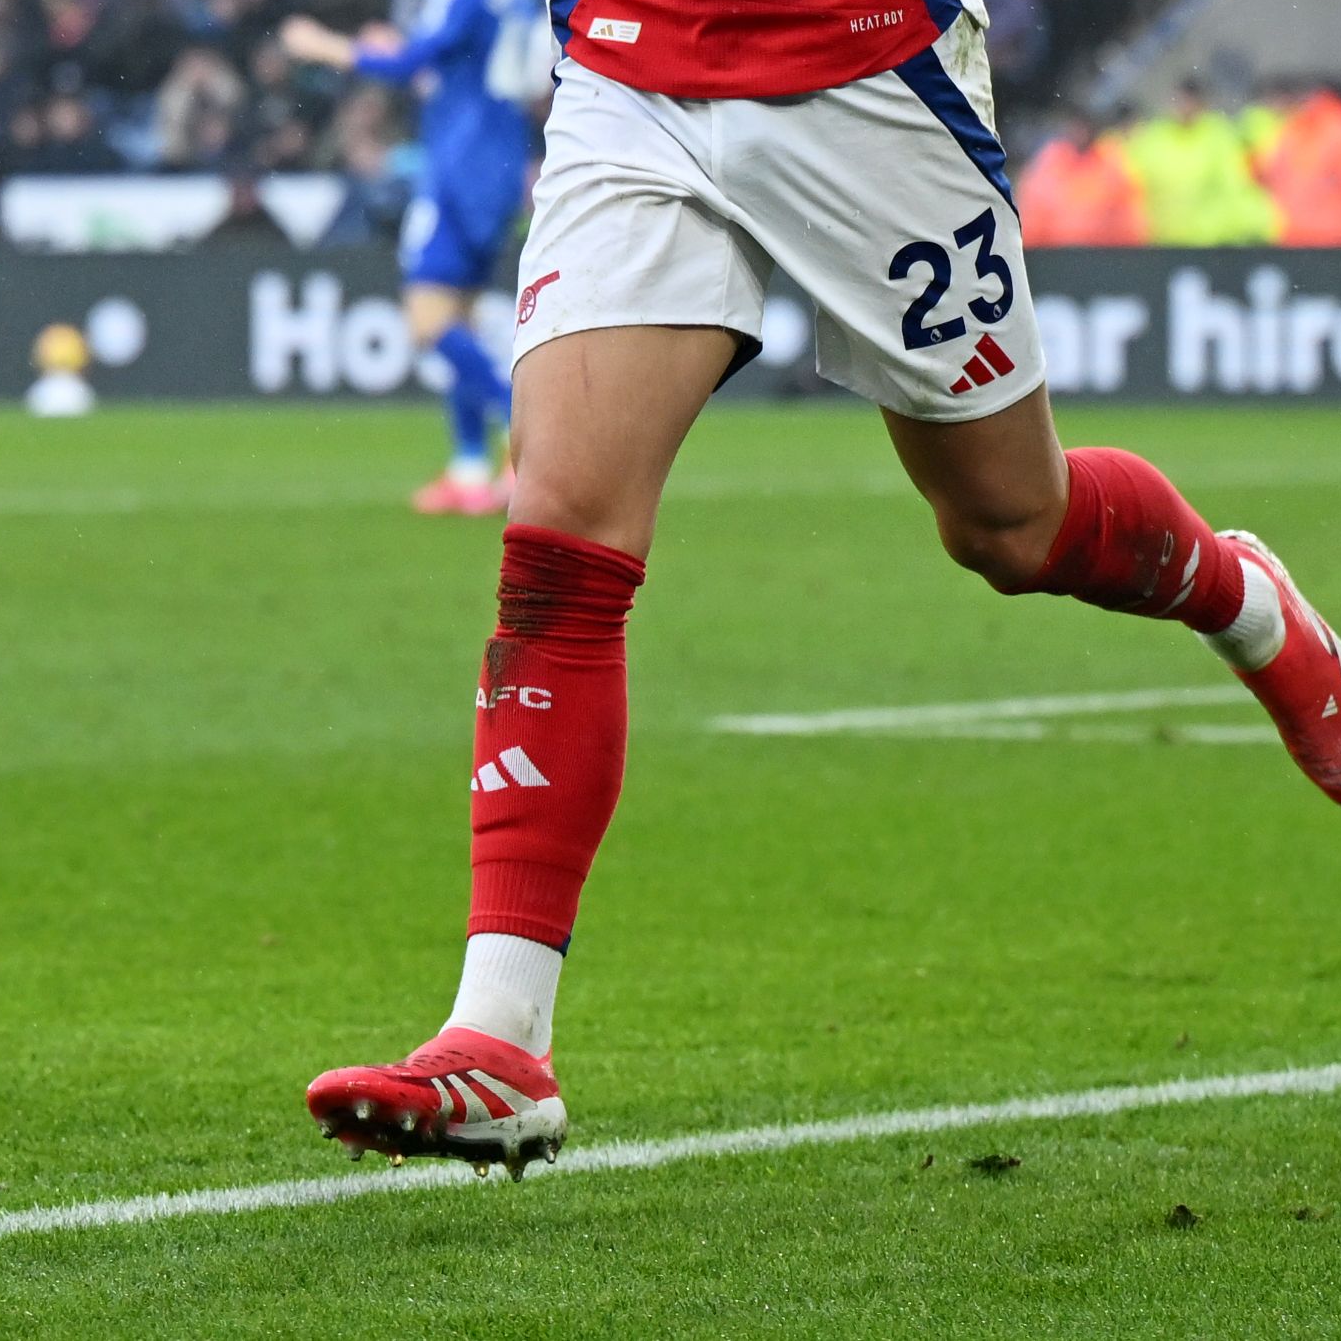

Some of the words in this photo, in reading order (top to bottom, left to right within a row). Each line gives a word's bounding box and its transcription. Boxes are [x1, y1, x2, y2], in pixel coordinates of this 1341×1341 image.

[888, 206, 1014, 351] 23
[1034, 292, 1148, 396] ar
[475, 685, 553, 711] AFC
